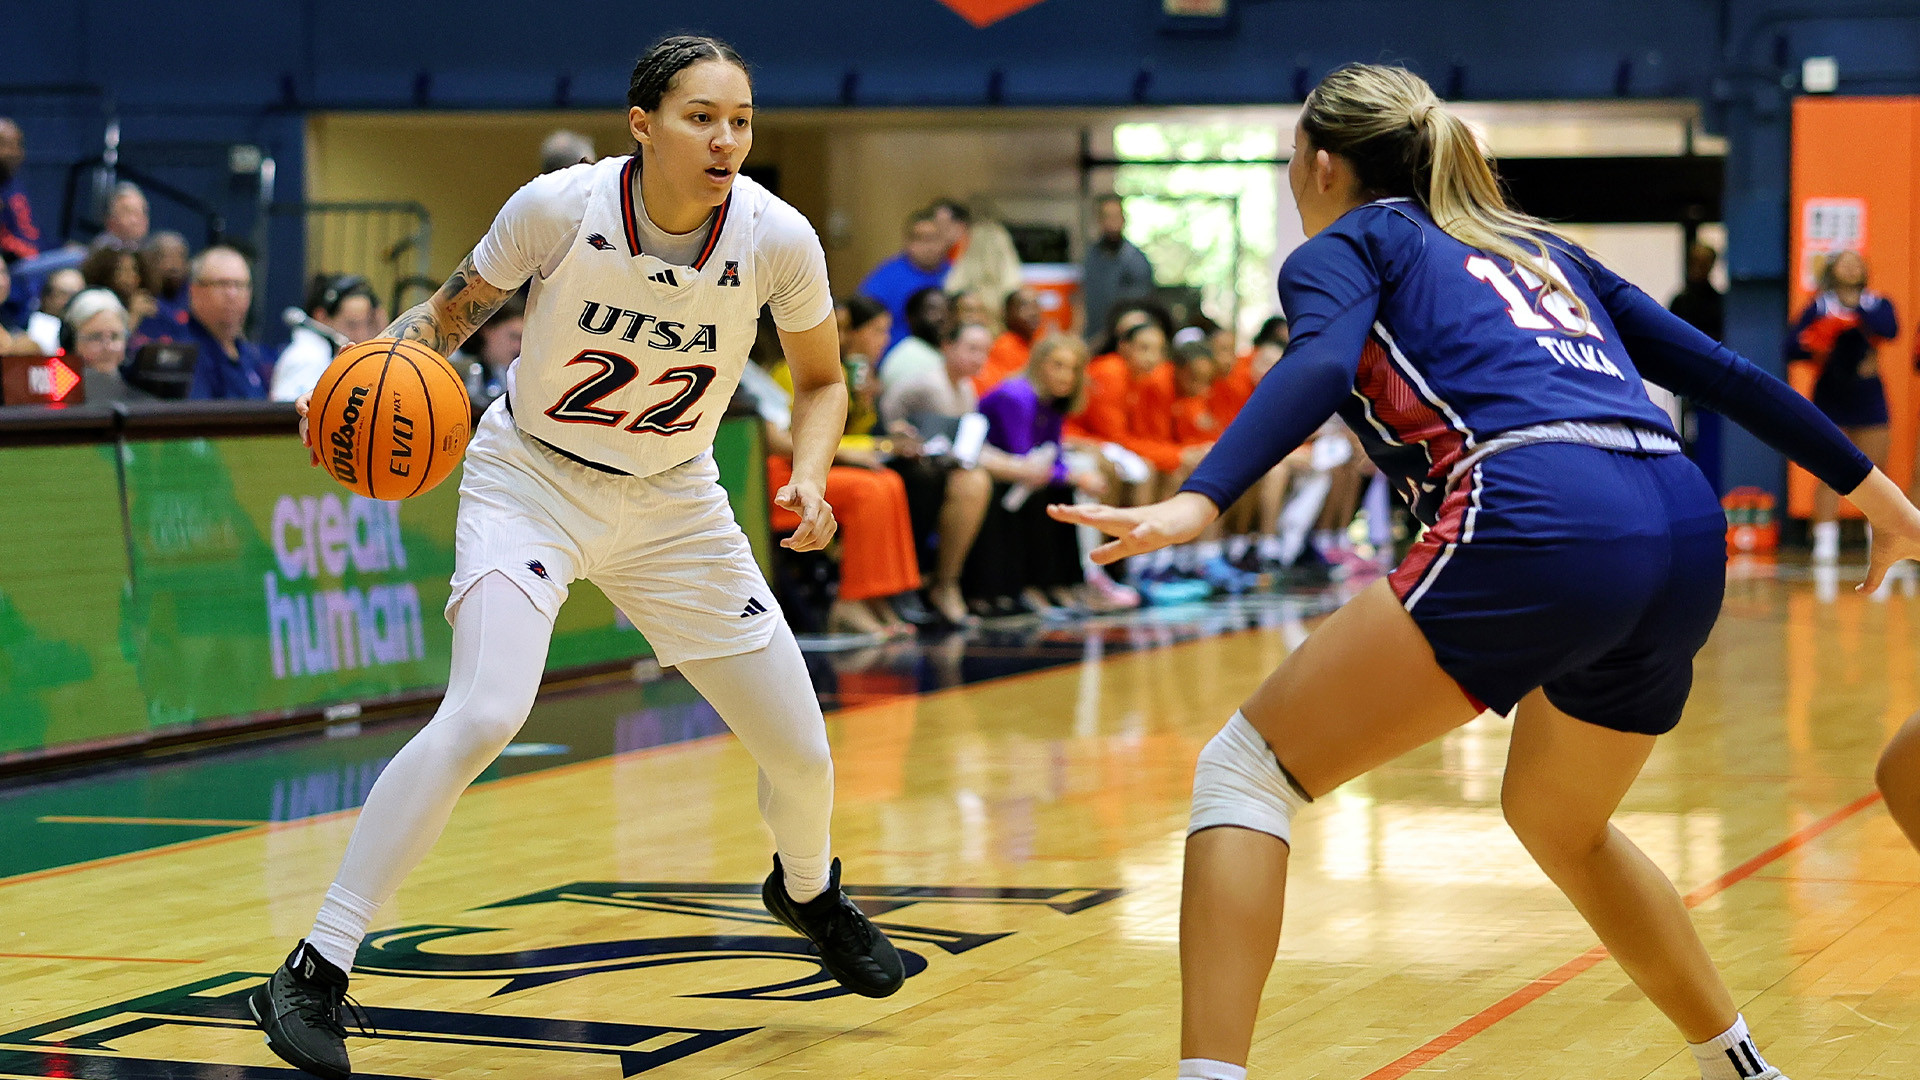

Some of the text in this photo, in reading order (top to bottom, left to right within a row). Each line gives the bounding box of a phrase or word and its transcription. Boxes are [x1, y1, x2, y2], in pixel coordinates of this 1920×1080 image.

[578, 300, 717, 353] UTSA
[1464, 255, 1606, 343] 12
[544, 349, 717, 437] 22
[1535, 336, 1626, 381] TYLKA
[331, 386, 369, 484] Wilson
[389, 413, 414, 477] EVO
[264, 571, 425, 679] human
